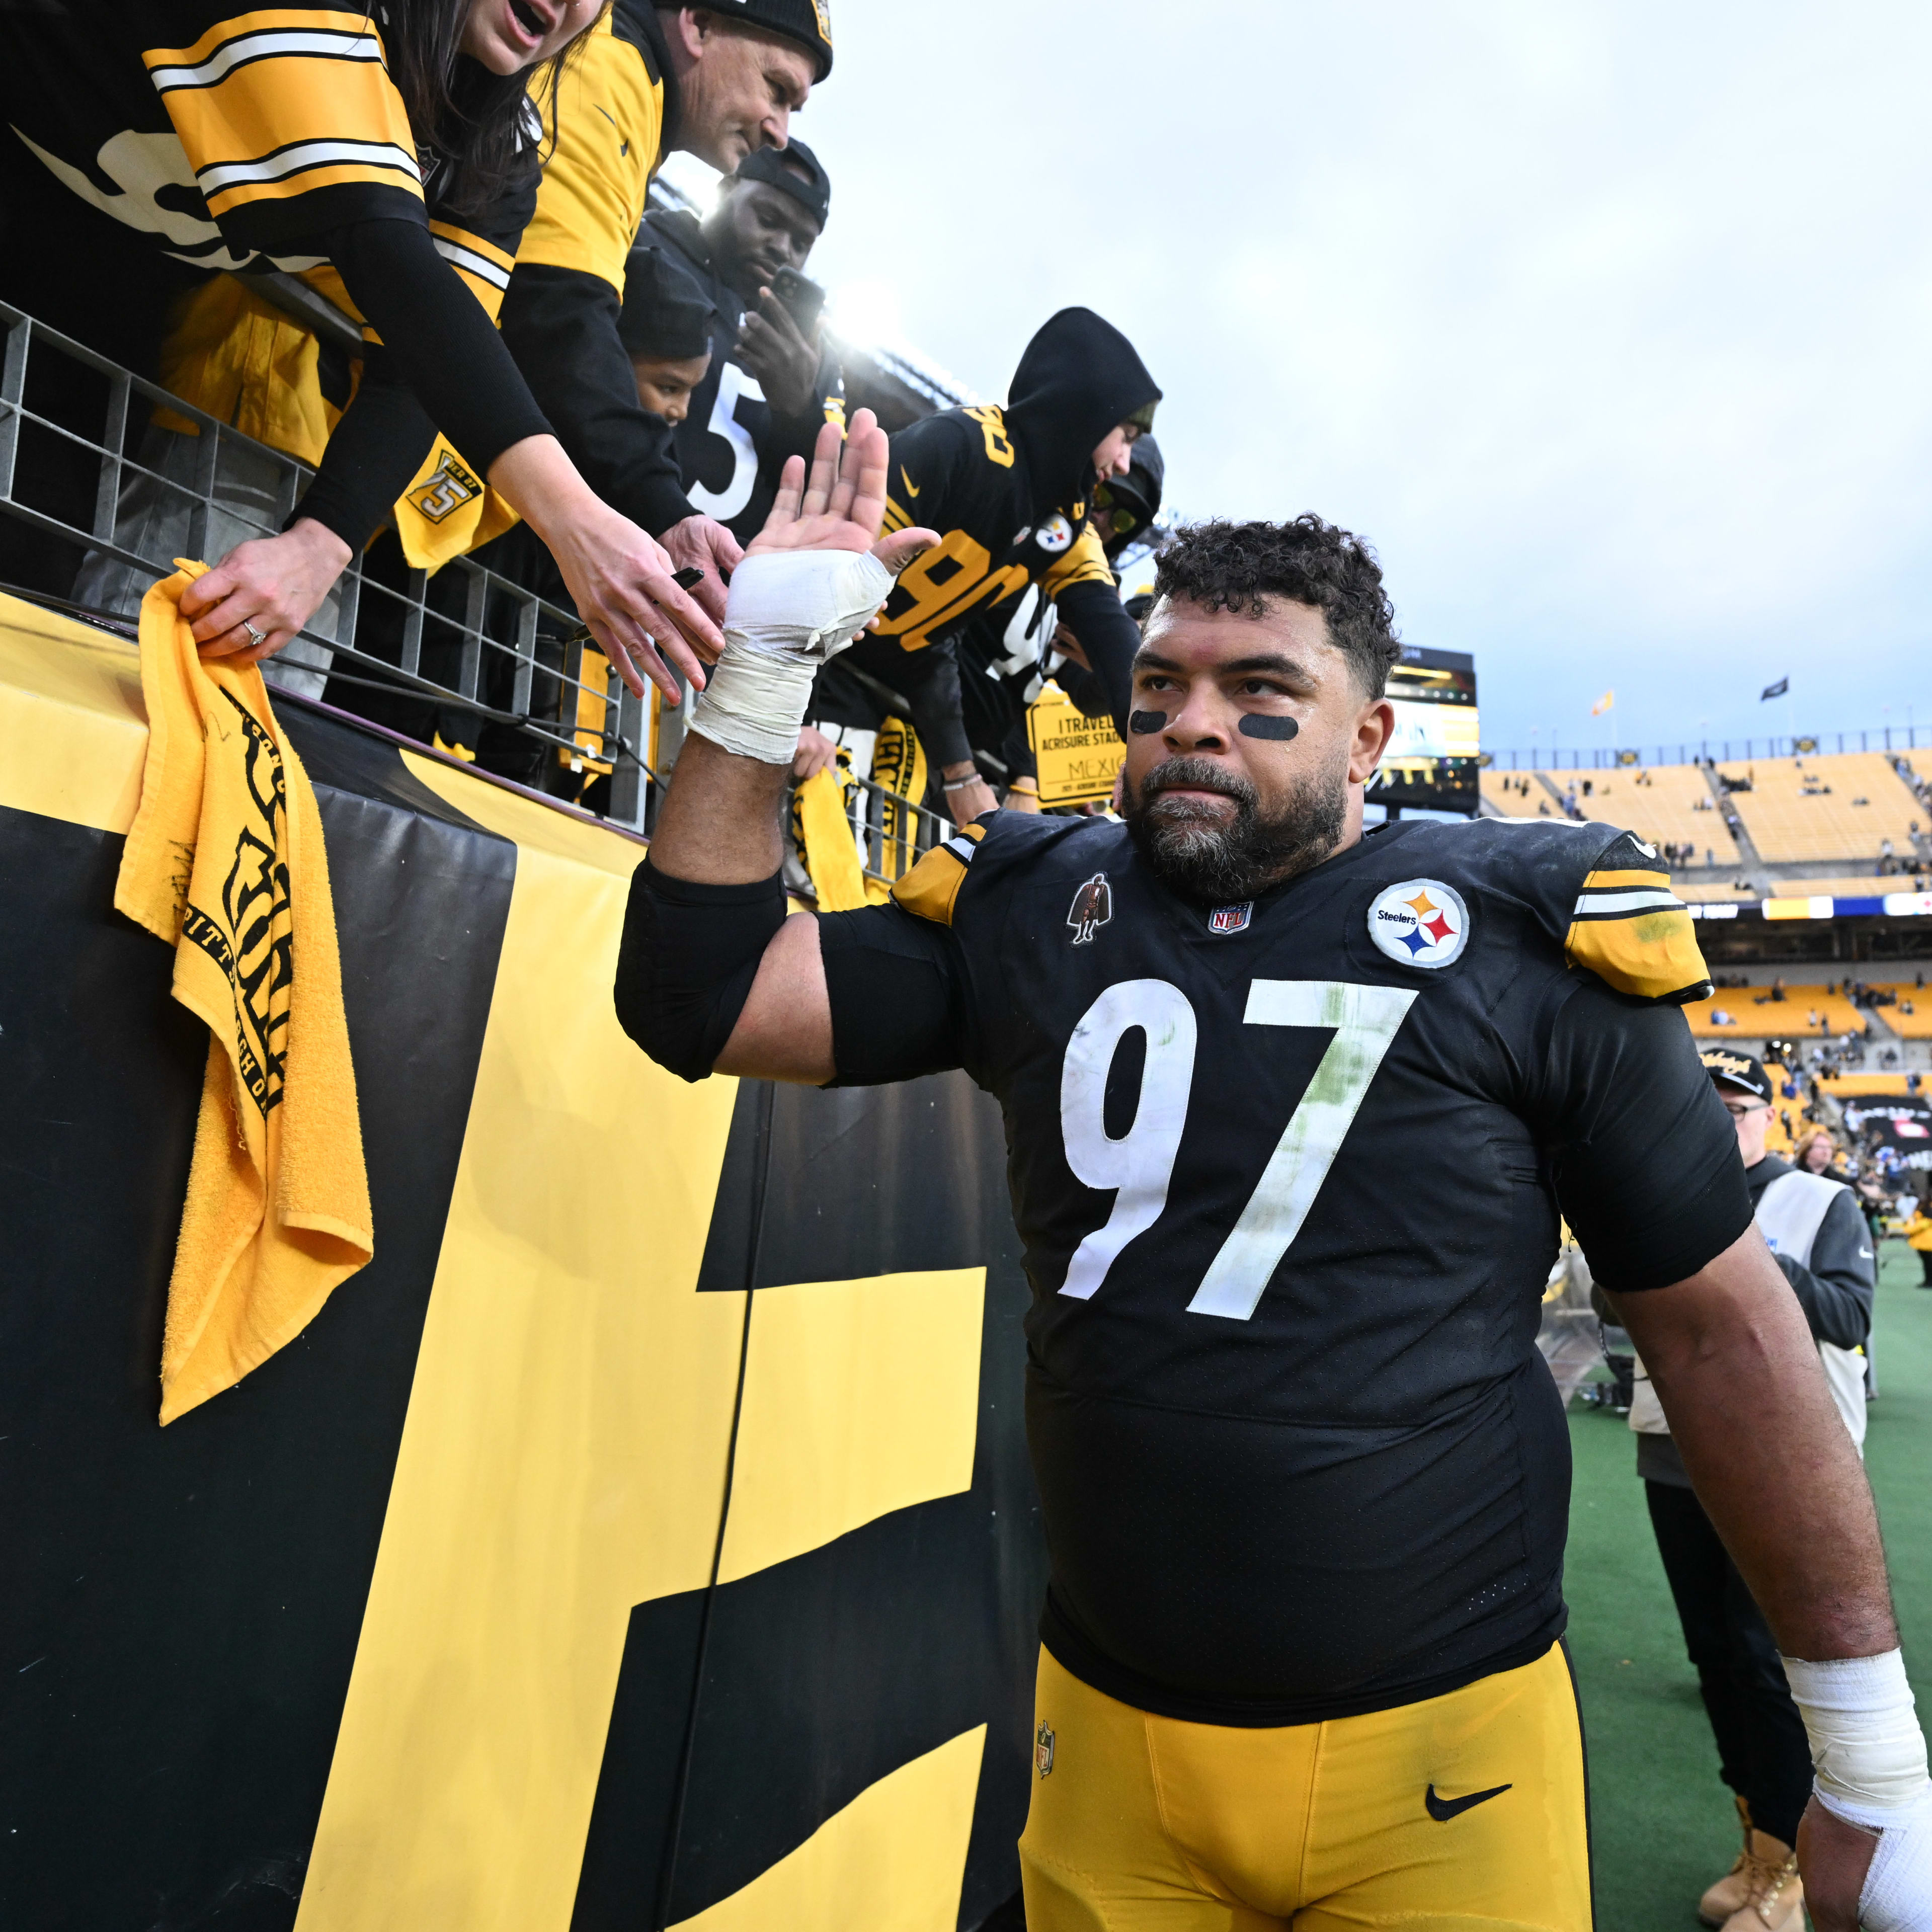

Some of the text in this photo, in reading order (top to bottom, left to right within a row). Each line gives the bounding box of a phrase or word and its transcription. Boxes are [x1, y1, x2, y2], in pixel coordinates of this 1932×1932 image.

[1059, 719, 1063, 734] I
[1042, 735, 1090, 750] ACRISURE
[1214, 912, 1243, 929] NFL
[1378, 910, 1416, 925] Steelers
[1058, 978, 1419, 1321] 97
